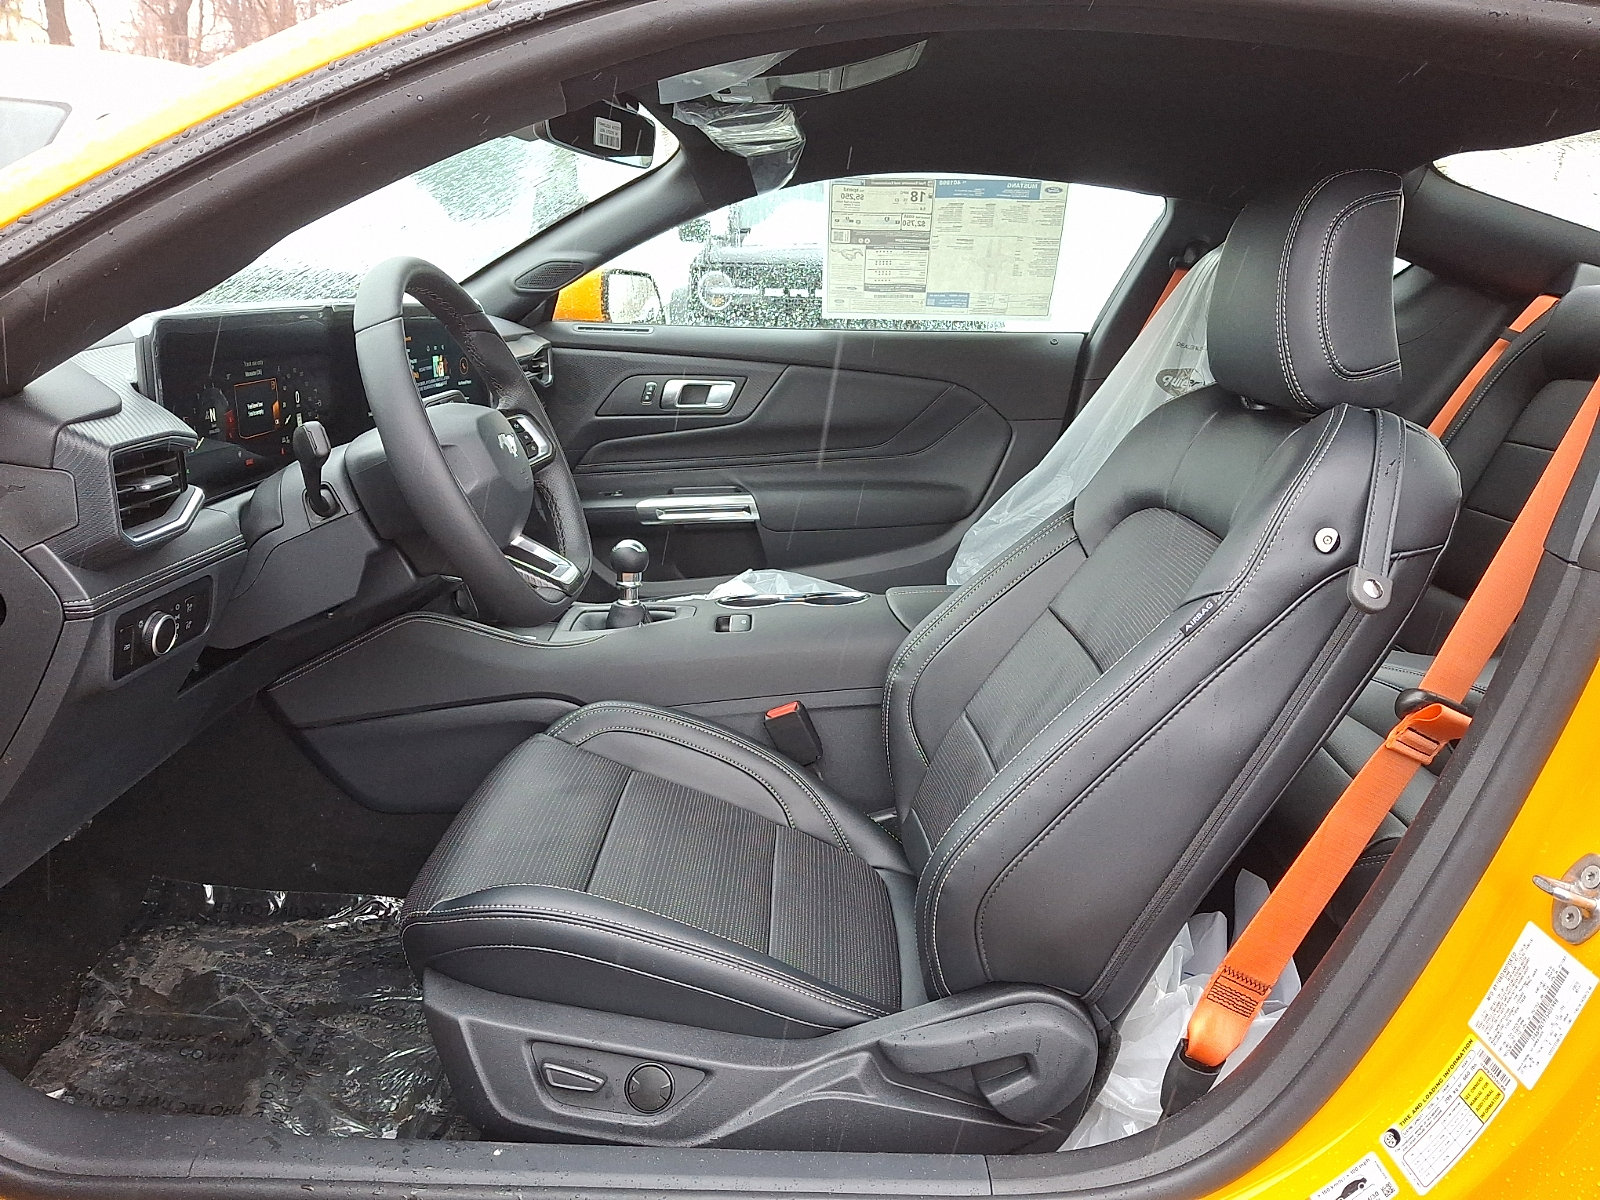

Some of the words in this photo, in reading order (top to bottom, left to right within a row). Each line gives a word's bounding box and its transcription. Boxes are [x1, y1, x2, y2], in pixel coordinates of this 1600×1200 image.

[1185, 601, 1214, 632] AIRBAG
[1399, 1113, 1412, 1126] TIRE
[1412, 1102, 1423, 1115] AND
[1423, 1078, 1443, 1102] LOADING
[1443, 1039, 1474, 1077] INFORMATION
[1469, 1090, 1482, 1106] MANUAL
[1479, 1092, 1501, 1118] INFORMATION
